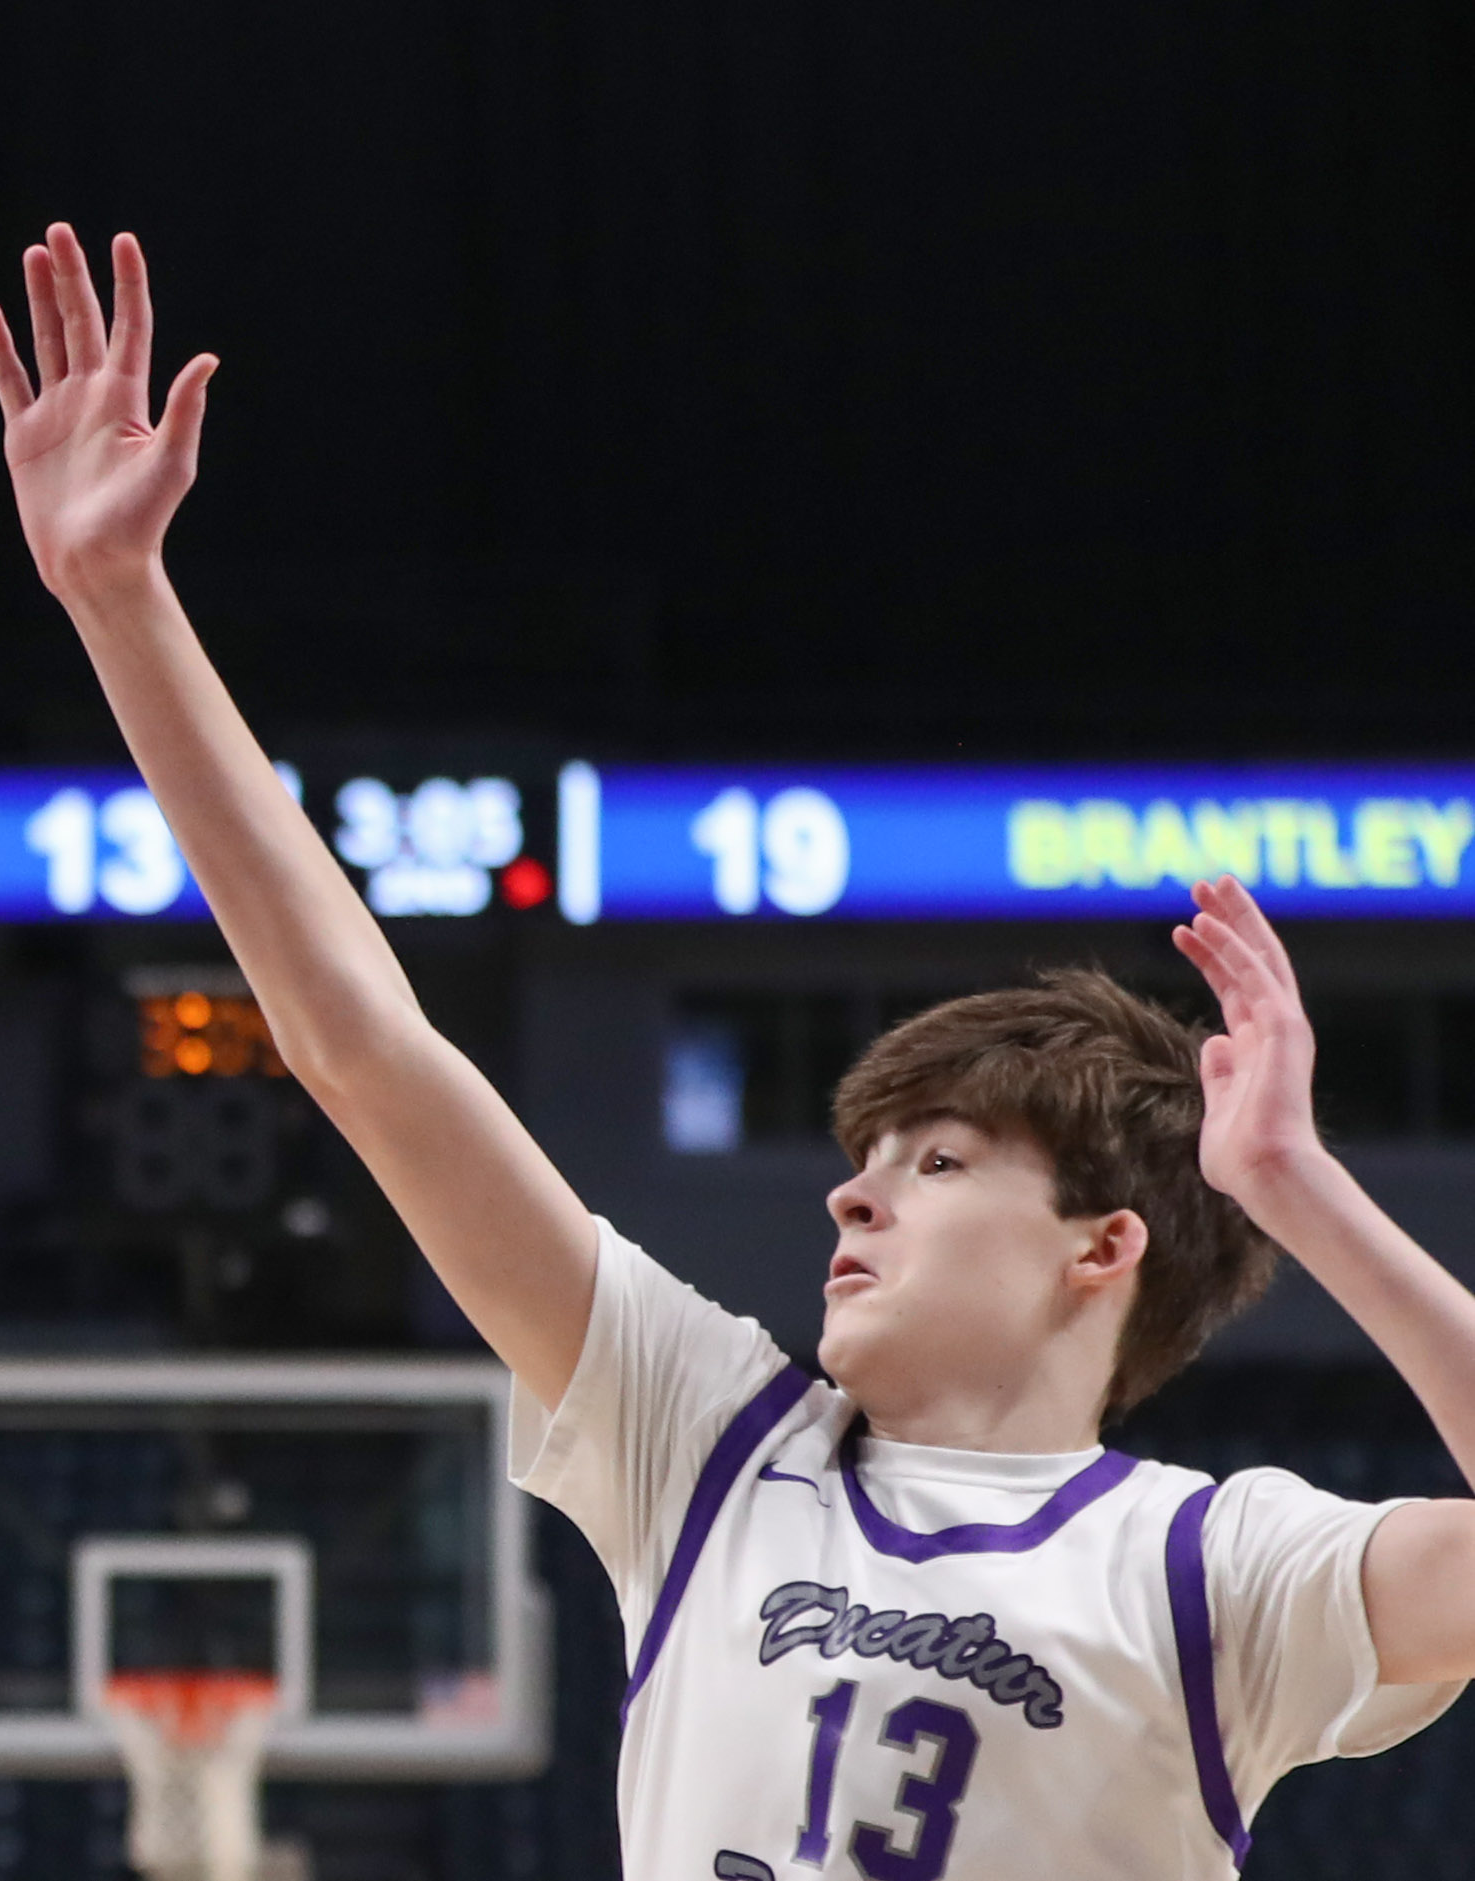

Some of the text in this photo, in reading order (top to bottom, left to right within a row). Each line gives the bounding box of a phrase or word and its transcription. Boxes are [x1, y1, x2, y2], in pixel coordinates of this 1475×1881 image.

[28, 786, 188, 916] 13
[690, 786, 851, 916] 19
[1010, 799, 1472, 888] BRANTLEY
[759, 1580, 1064, 1729] Decatur
[791, 1677, 982, 1881] 13
